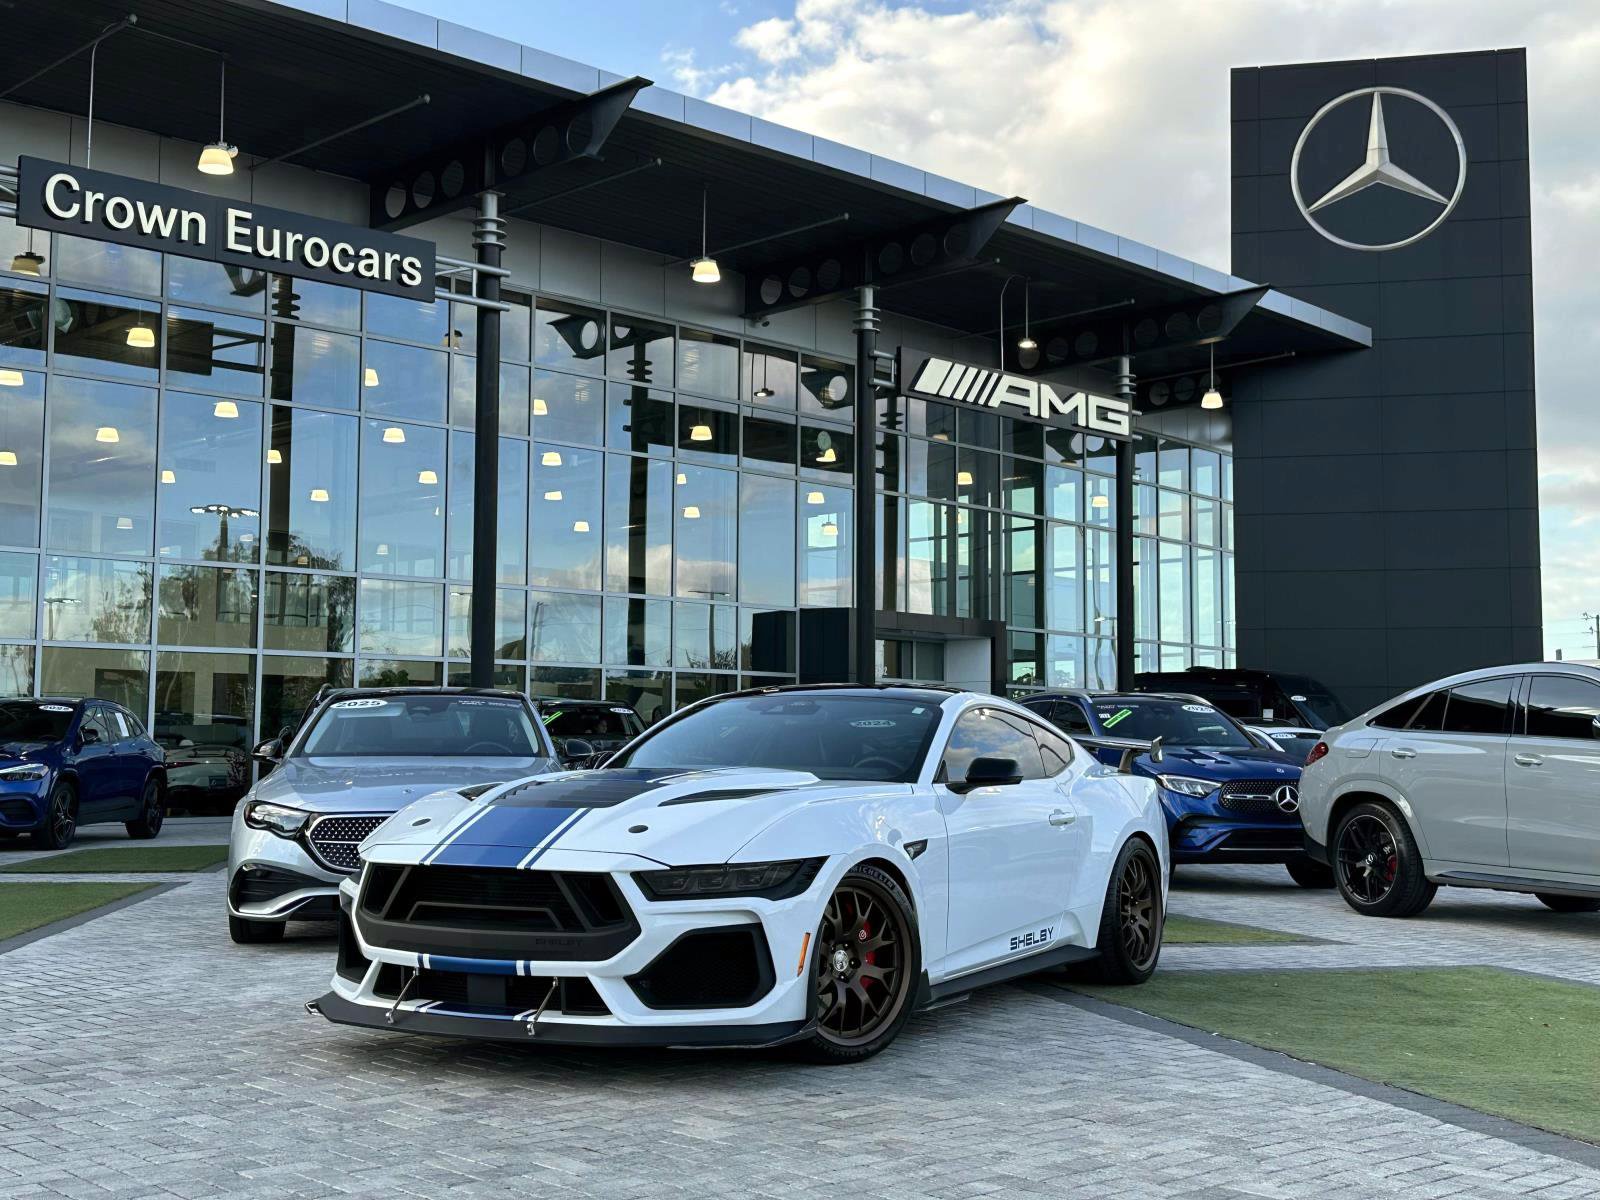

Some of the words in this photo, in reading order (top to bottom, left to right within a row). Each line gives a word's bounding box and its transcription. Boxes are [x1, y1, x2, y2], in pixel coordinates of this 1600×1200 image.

[43, 172, 207, 245] Crown
[224, 206, 423, 287] Eurocars
[987, 373, 1130, 436] AMG
[335, 700, 382, 708] 2025
[850, 864, 896, 890] MICHELIN
[1010, 926, 1054, 951] SHELBY
